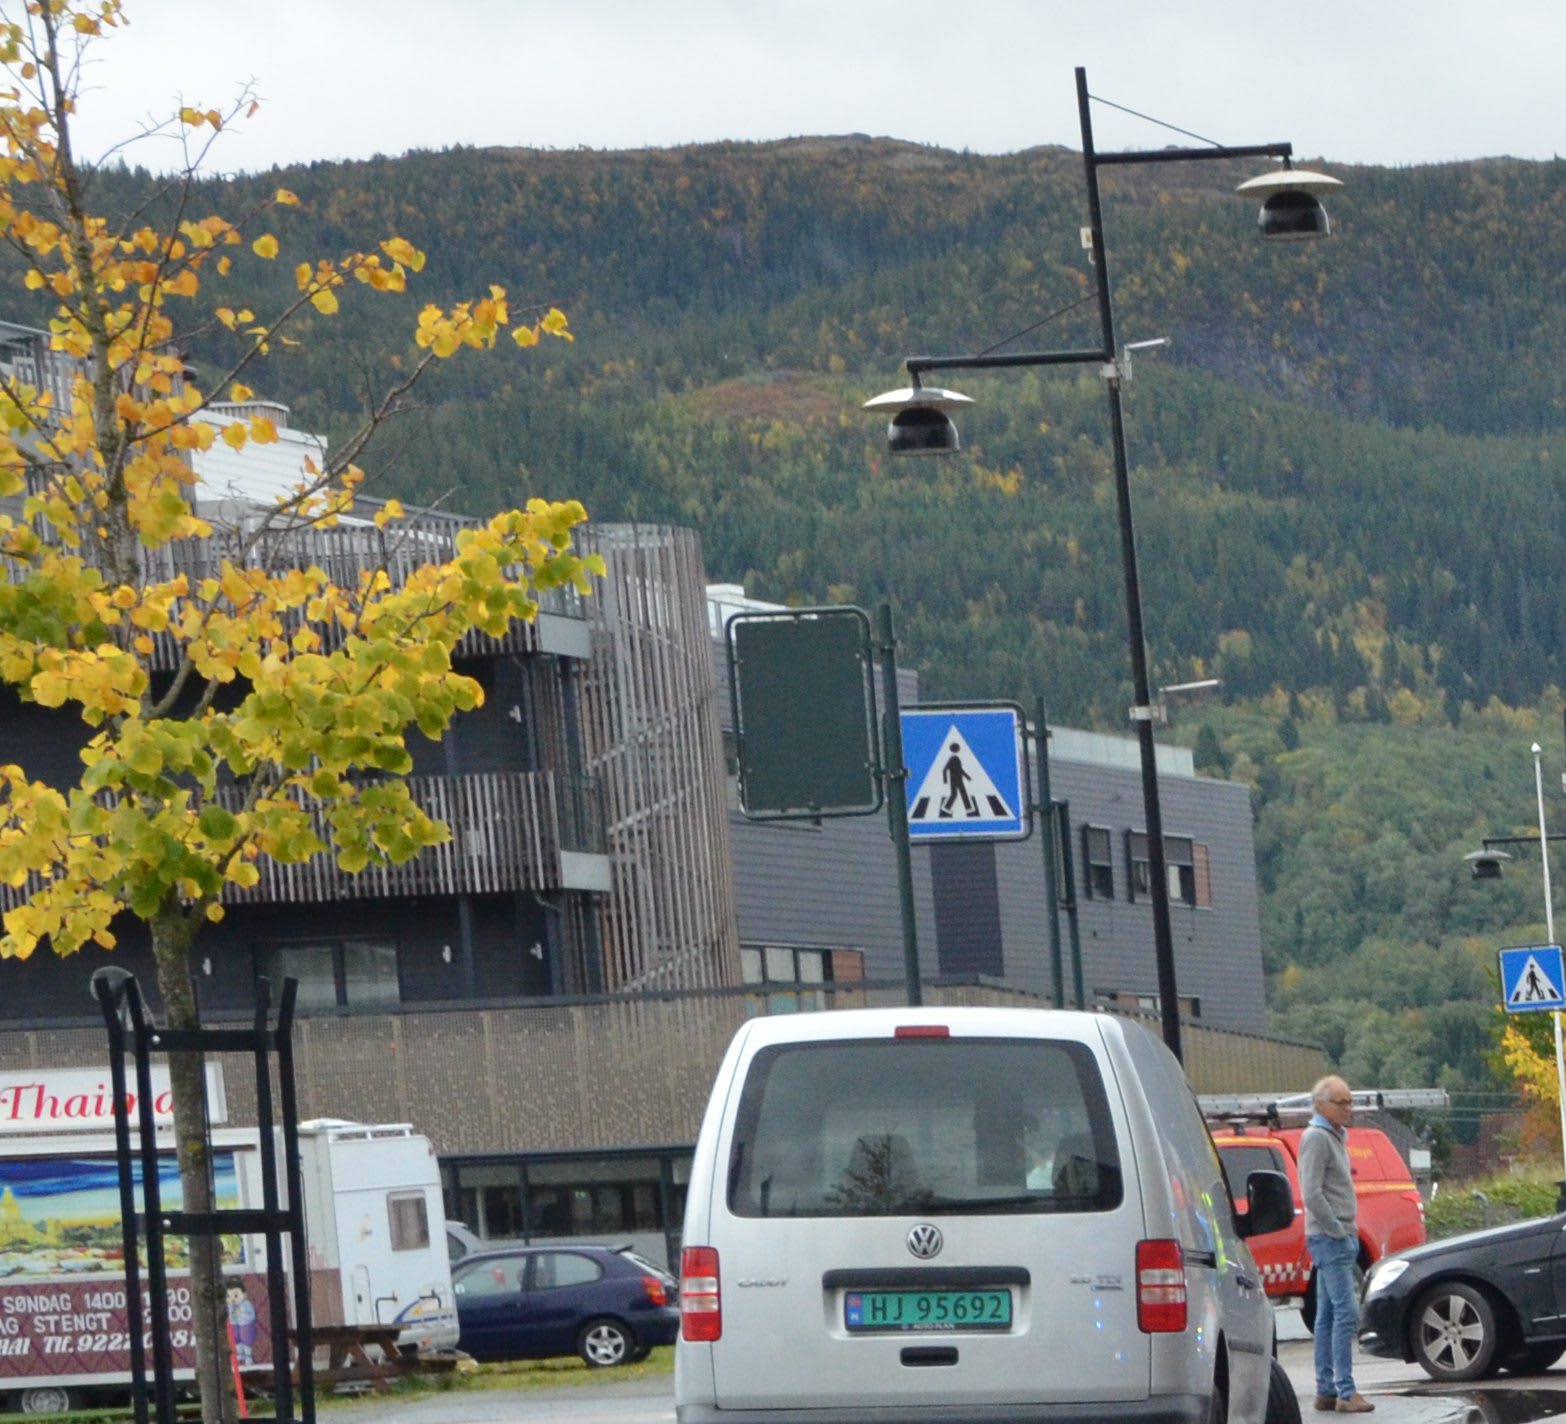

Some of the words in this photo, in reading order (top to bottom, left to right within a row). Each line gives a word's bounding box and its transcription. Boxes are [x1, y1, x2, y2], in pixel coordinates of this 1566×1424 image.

[4, 1293, 72, 1314] SØNDAG
[870, 1296, 904, 1321] HJ
[916, 1294, 1004, 1321] 95692
[34, 1311, 112, 1333] STENGT
